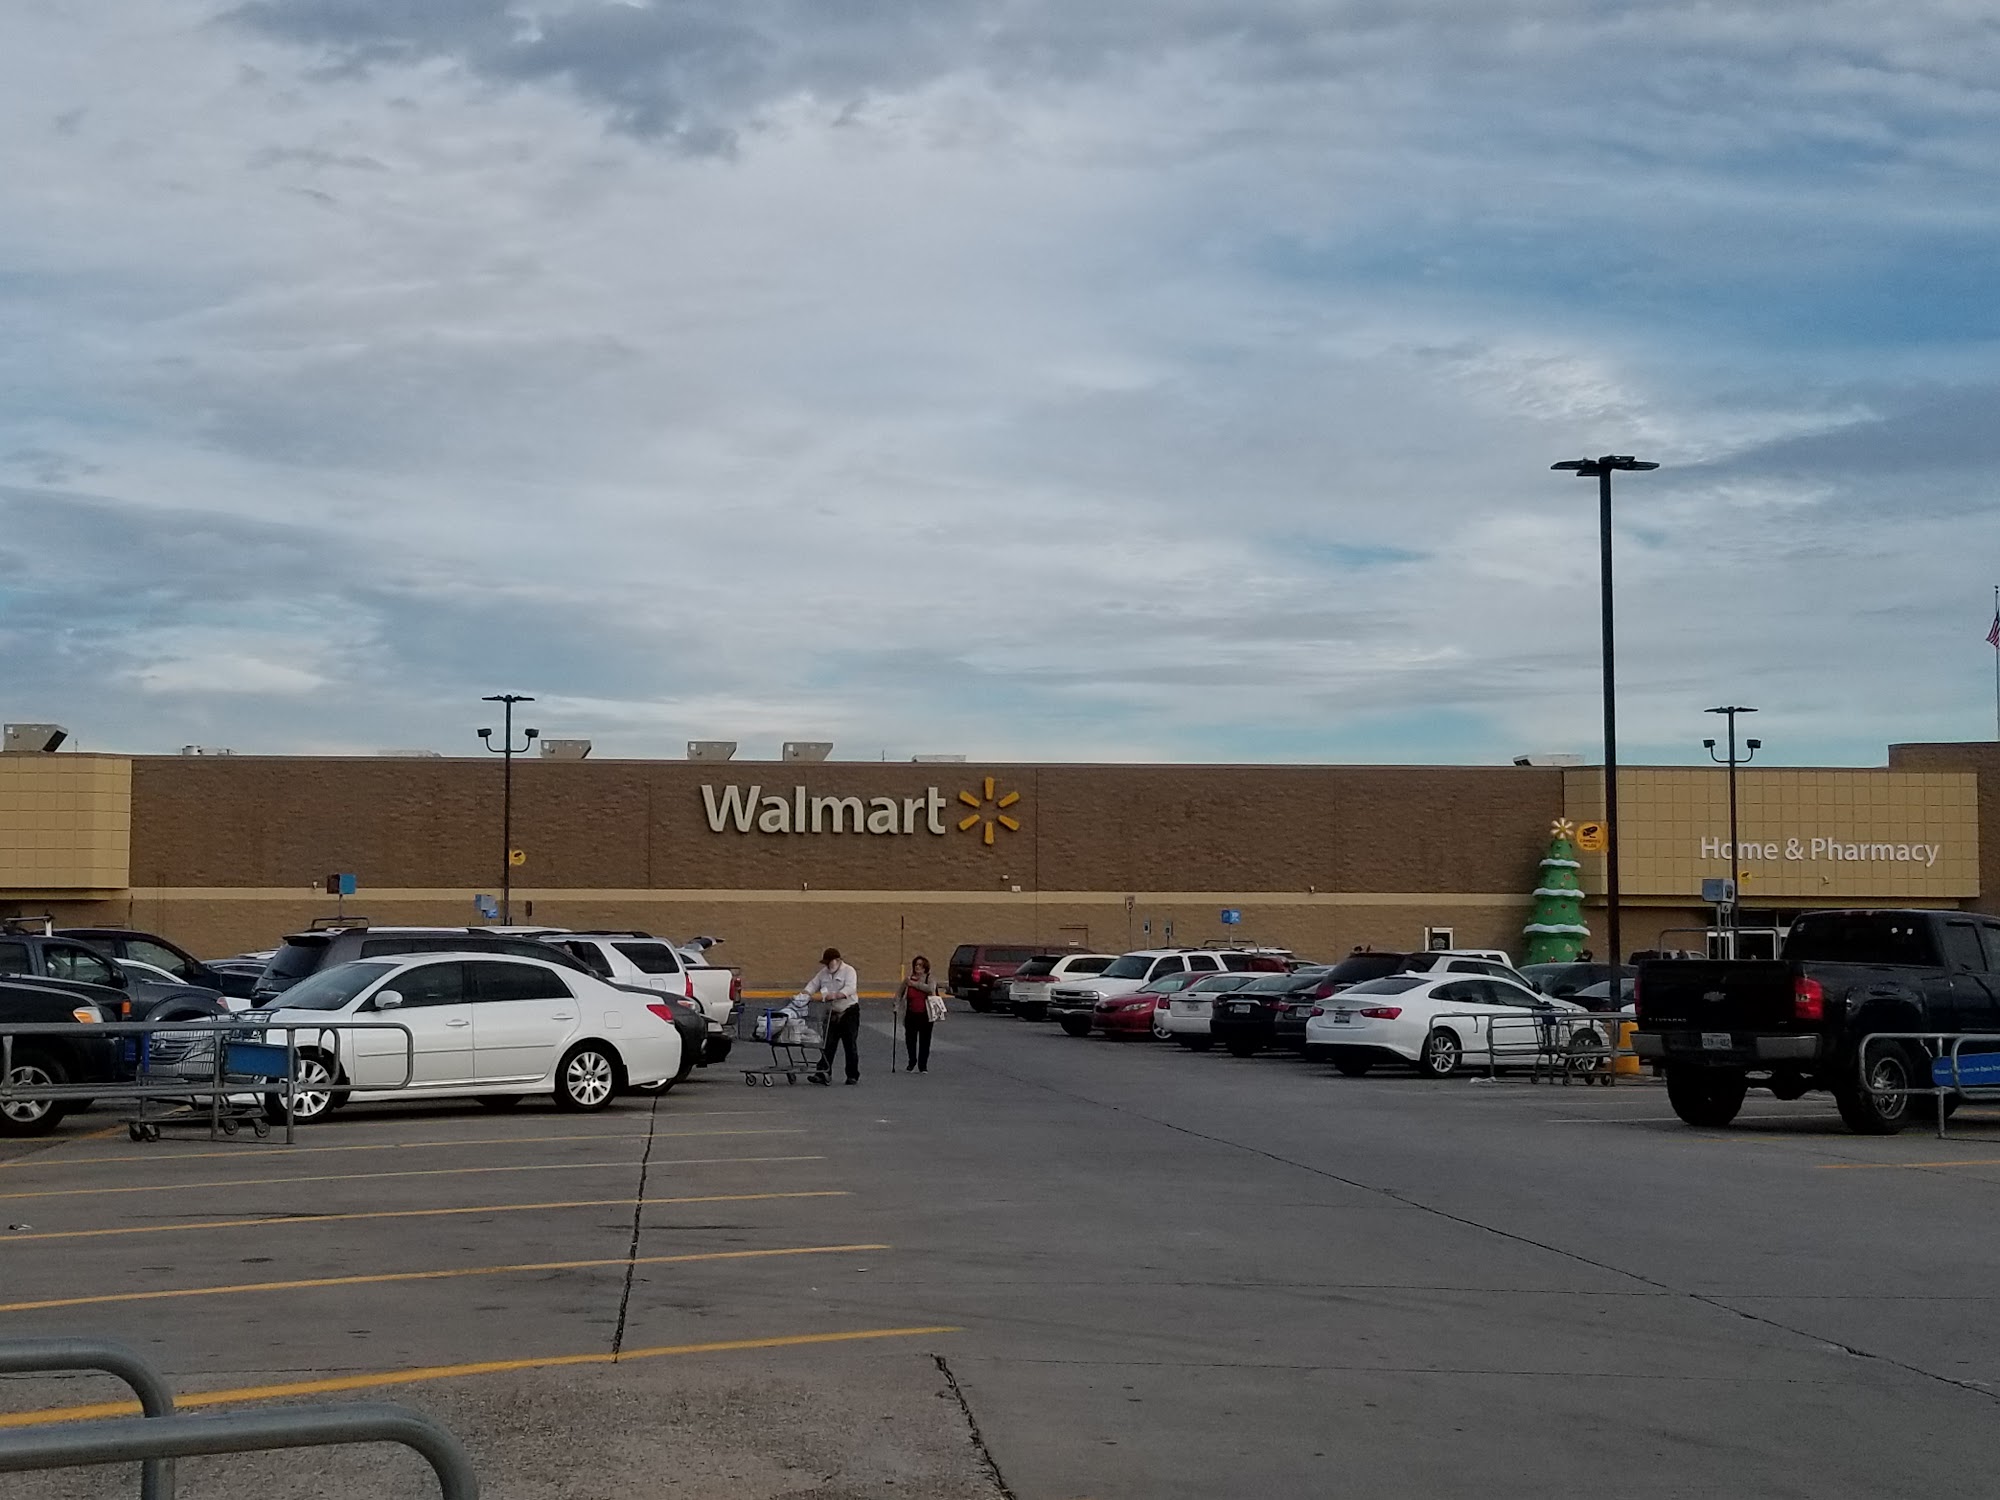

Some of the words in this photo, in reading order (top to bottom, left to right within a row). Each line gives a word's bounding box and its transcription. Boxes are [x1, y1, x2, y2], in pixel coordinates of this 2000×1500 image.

[701, 785, 947, 835] Walmart
[1700, 837, 1779, 860] Home
[1785, 838, 1804, 861] &
[1811, 838, 1940, 868] Pharmacy
